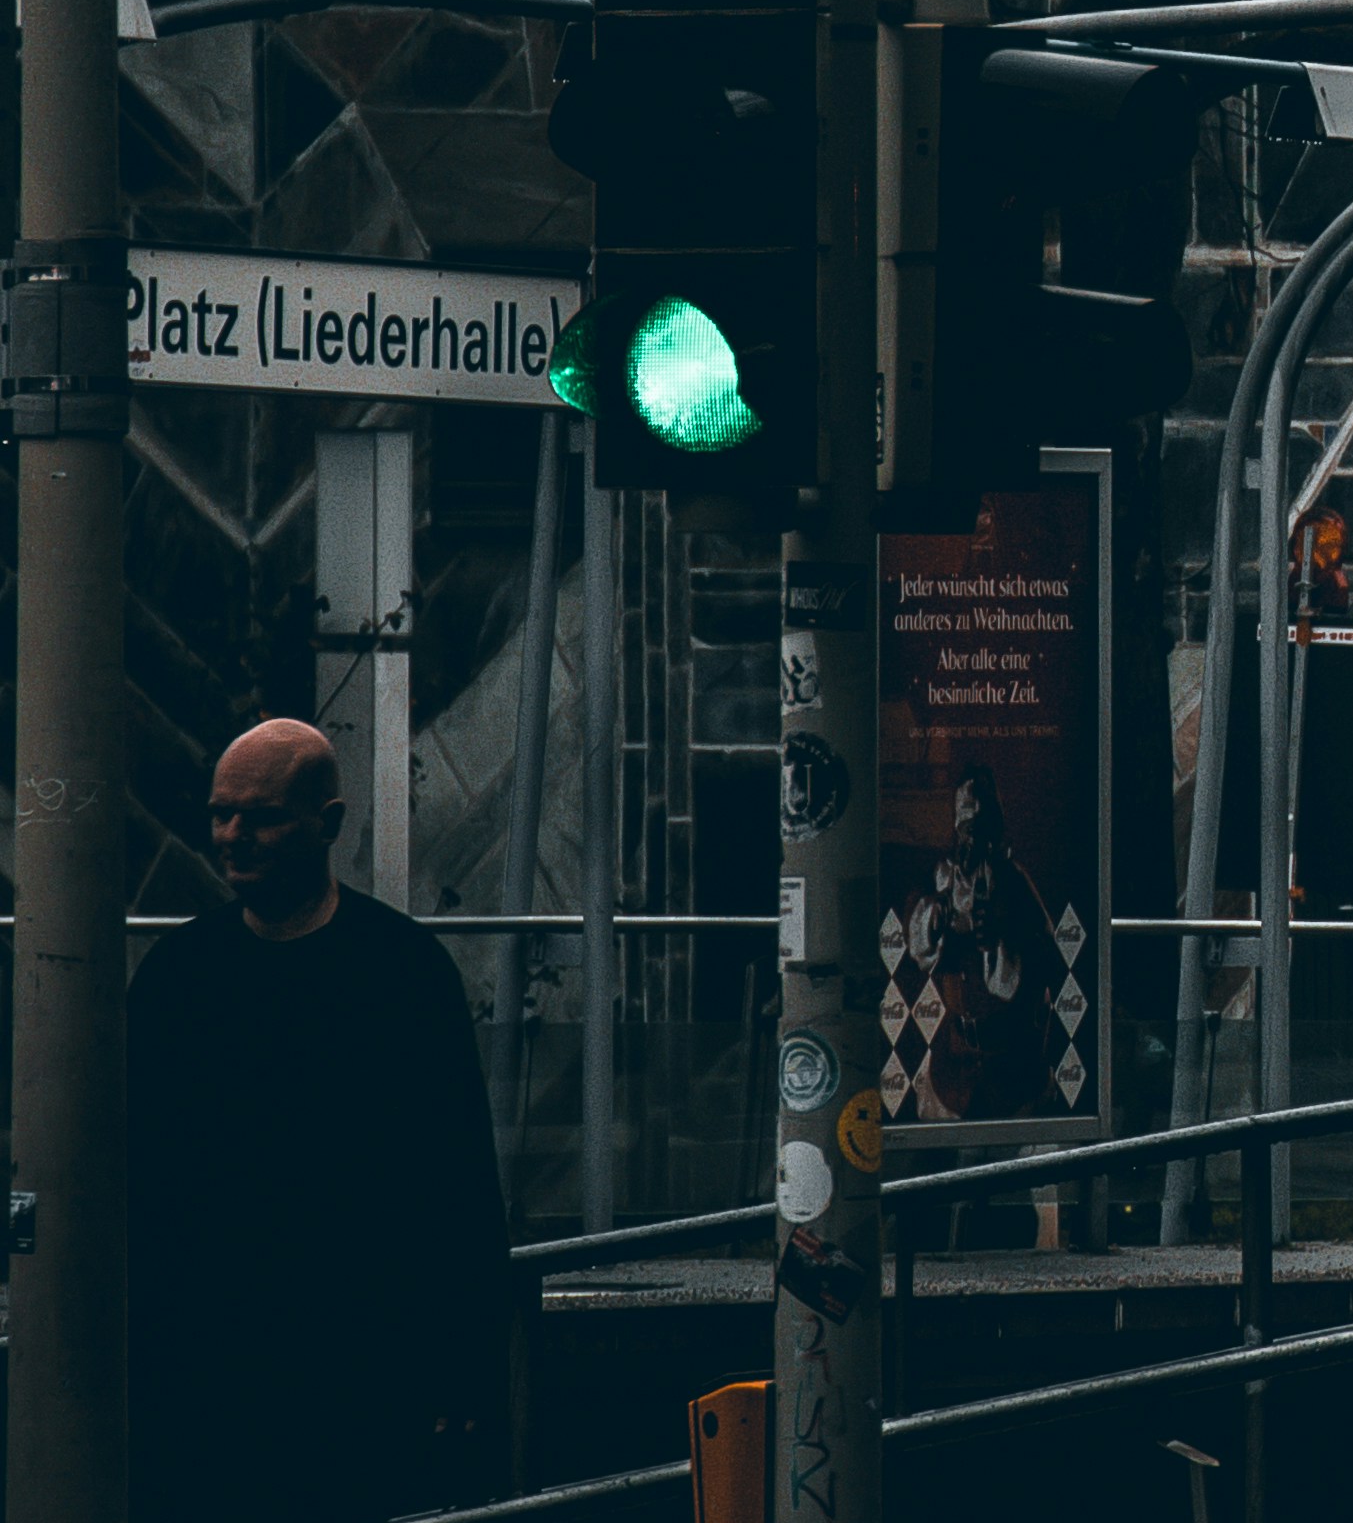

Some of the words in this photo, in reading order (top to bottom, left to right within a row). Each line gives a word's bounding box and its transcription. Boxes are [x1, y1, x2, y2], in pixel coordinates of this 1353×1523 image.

[899, 572, 933, 603] Jeder
[937, 573, 996, 598] wünscht
[998, 573, 1028, 598] sich
[1029, 578, 1070, 598] etwas
[894, 608, 952, 632] anderes
[955, 613, 971, 632] zu
[972, 606, 1074, 632] Weihnachten.
[937, 647, 968, 671] Aber
[971, 647, 998, 671] alle
[1000, 646, 1032, 671] eine
[927, 681, 1007, 705] besinnliche
[1009, 680, 1040, 705] Zeit.
